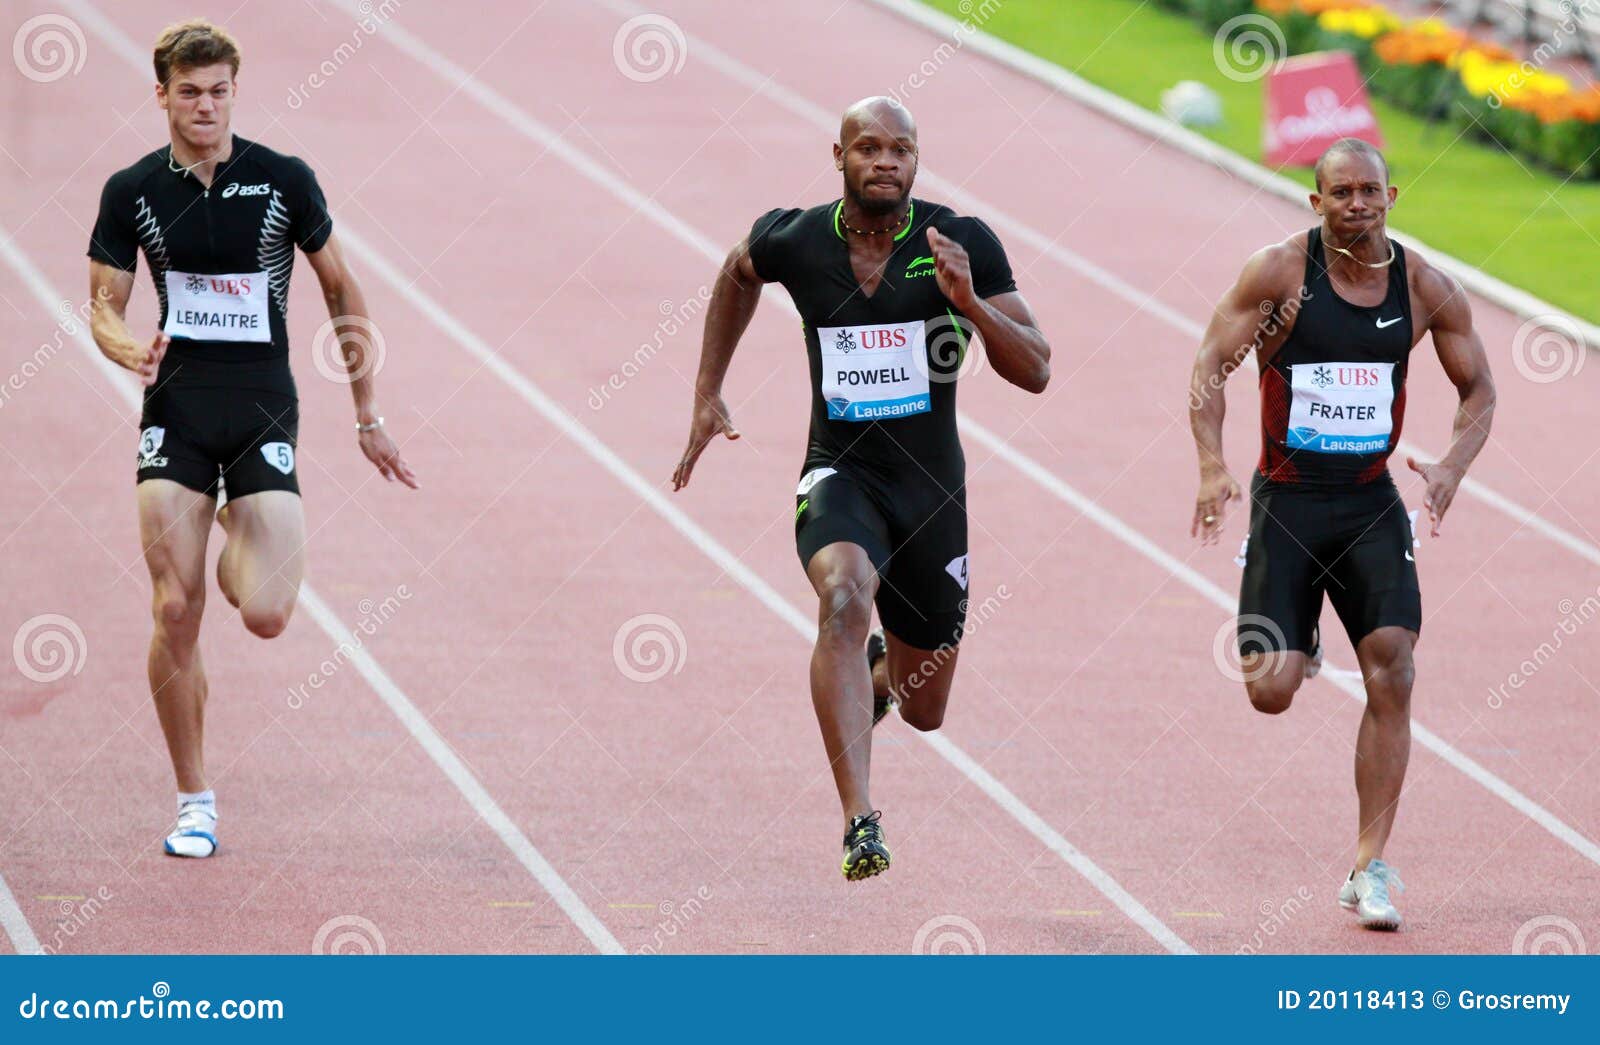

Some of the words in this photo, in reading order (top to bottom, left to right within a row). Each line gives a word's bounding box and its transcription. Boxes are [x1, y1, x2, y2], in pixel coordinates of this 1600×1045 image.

[239, 183, 270, 196] asics
[176, 310, 259, 328] LEMAITRE
[860, 328, 907, 350] UBS
[837, 367, 910, 386] POWELL
[1337, 368, 1379, 386] UBS
[854, 399, 927, 418] Lausanne
[1310, 402, 1376, 420] FRATER
[145, 432, 154, 453] 5
[1321, 438, 1385, 451] Lausanne
[277, 446, 290, 468] 5
[960, 558, 968, 581] 4
